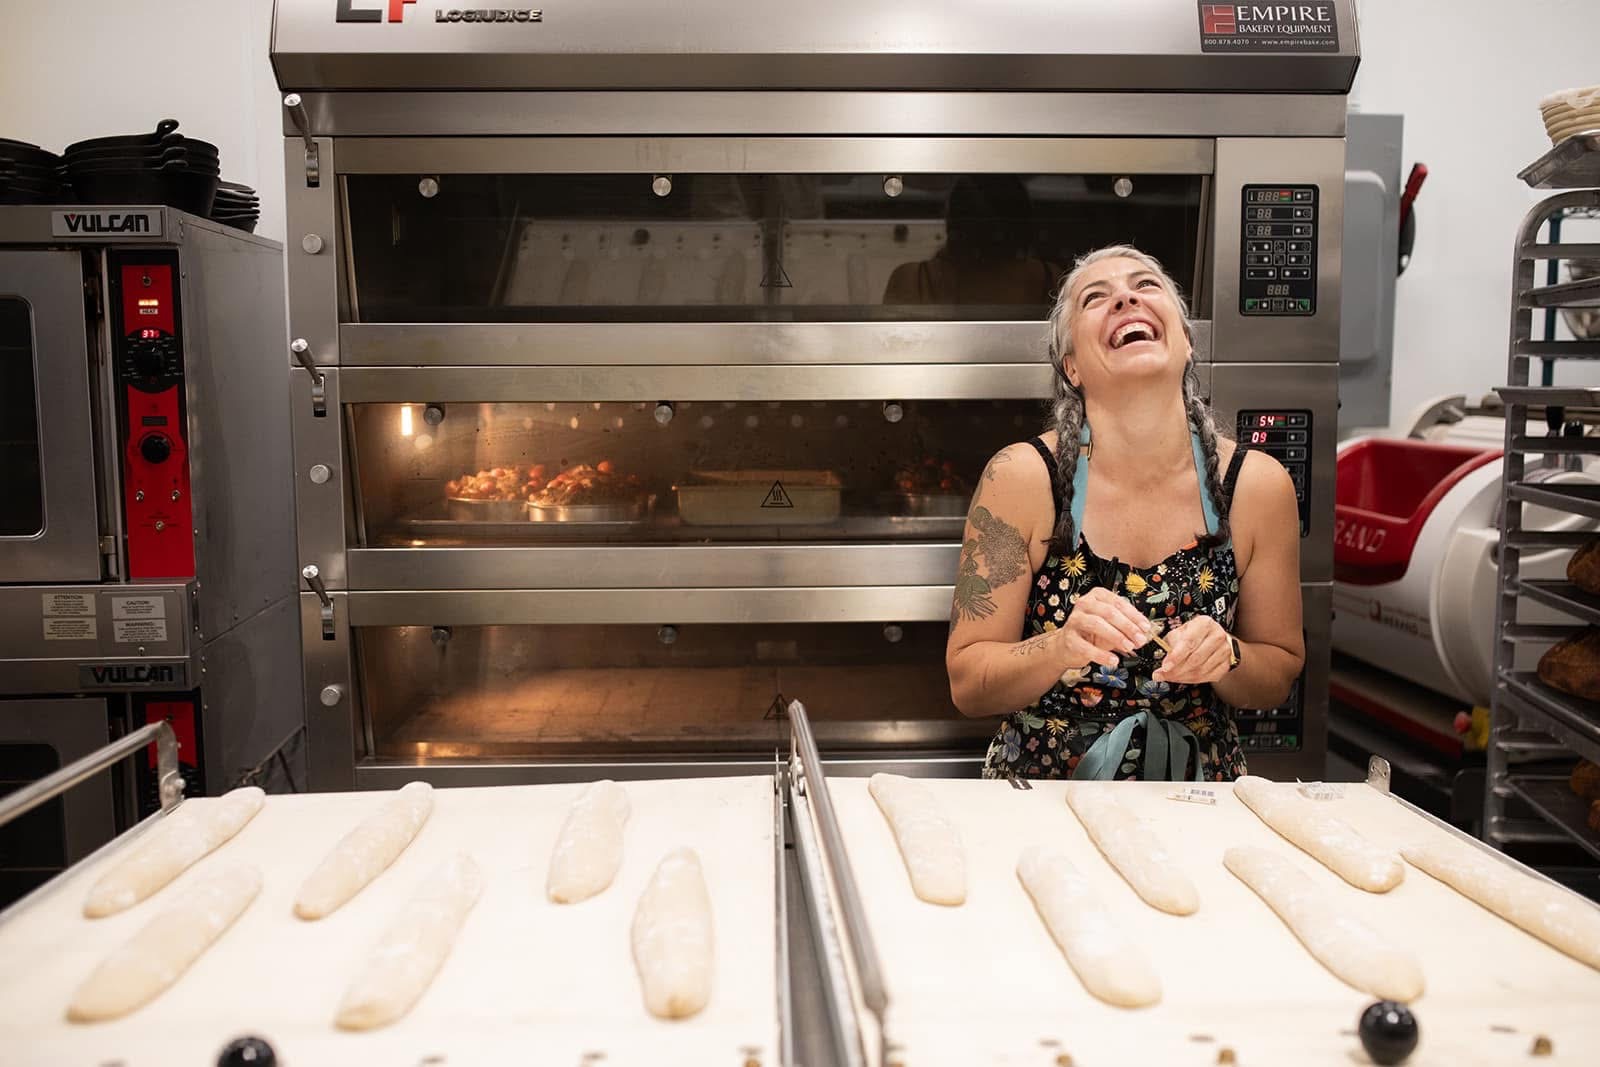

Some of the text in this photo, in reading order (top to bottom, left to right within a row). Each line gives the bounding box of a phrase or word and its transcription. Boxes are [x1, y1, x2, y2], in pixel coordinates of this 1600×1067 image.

[435, 9, 543, 23] LOGIUDICE
[1237, 5, 1331, 21] EMPIRE
[1239, 23, 1333, 34] BAKERY EQUIPMENT
[63, 213, 150, 233] VULCAN
[1251, 431, 1267, 443] 09
[90, 665, 174, 683] VULCAN
